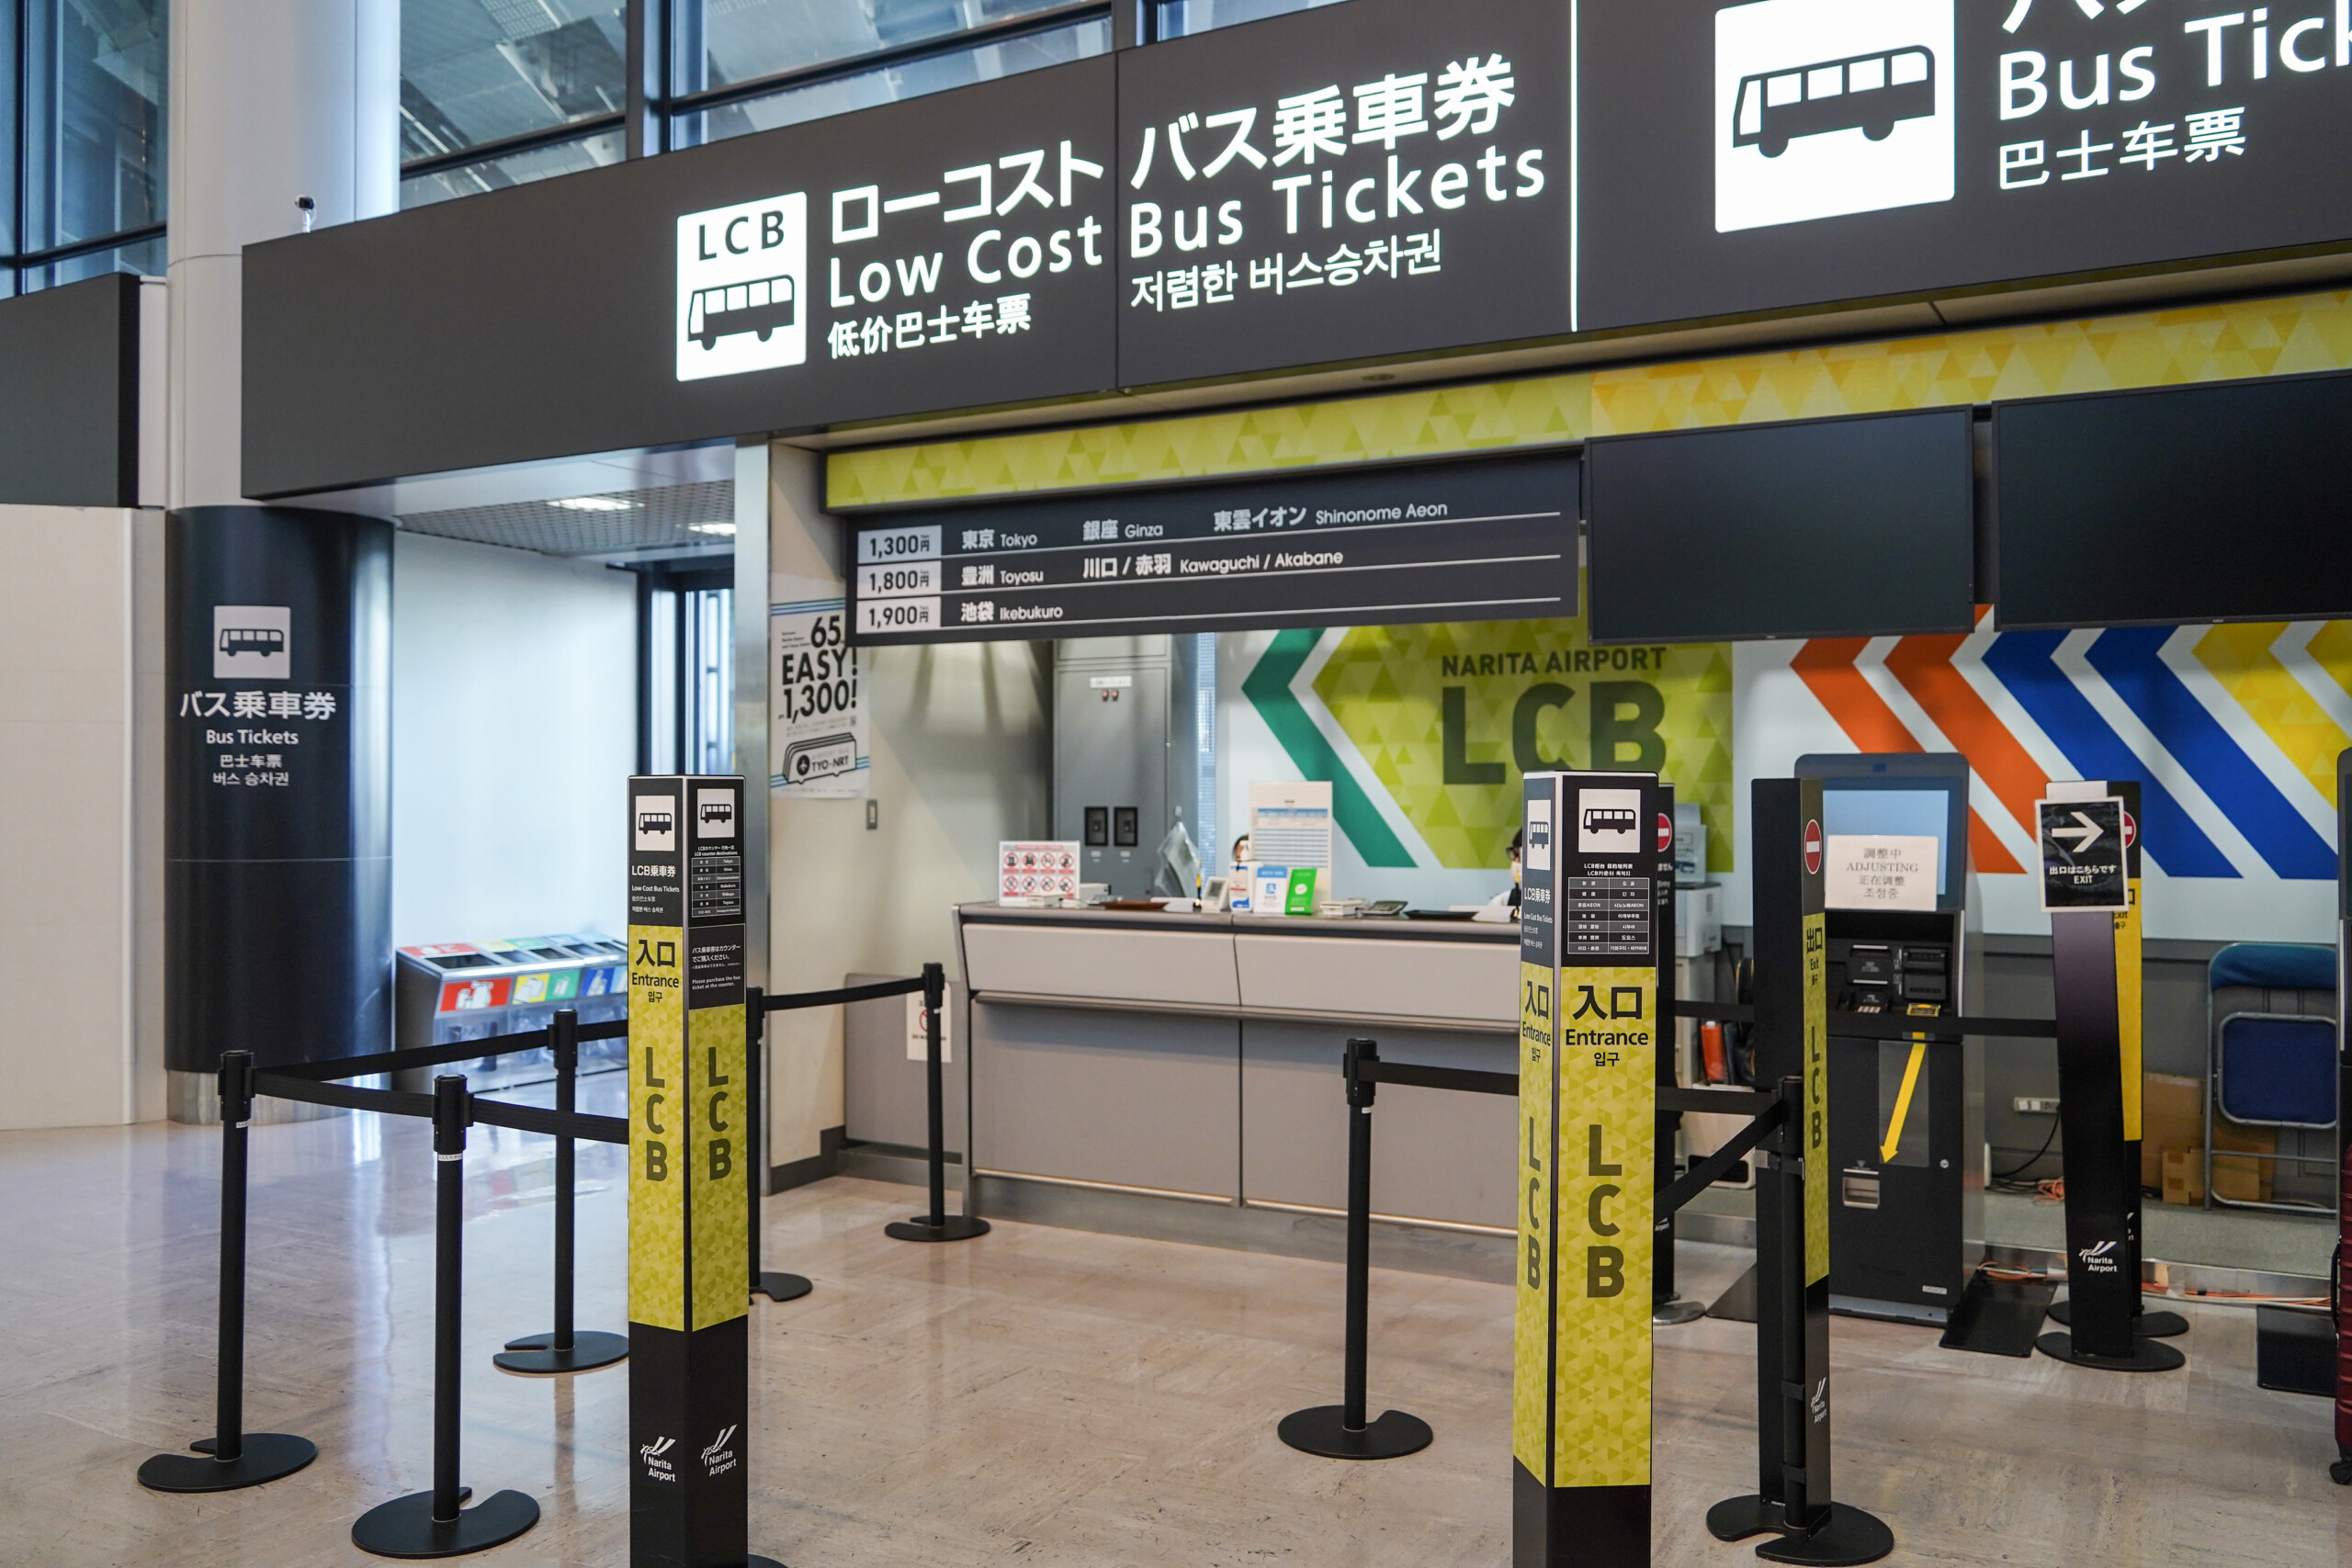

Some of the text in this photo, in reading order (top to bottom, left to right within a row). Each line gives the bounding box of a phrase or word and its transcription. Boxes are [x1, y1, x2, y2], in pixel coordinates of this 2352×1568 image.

[2000, 46, 2156, 120] Bus
[831, 52, 1515, 244] ローコスト バス乗車券
[2000, 107, 2245, 190] 巴士车票
[698, 209, 785, 261] LCB
[831, 144, 1544, 308] Low Cost Bus Tickets
[1131, 260, 1238, 312] 저렴한
[828, 292, 1031, 359] 低价巴士车票
[962, 529, 994, 550] 東京
[1001, 533, 1038, 548] Tokyo
[1083, 519, 1118, 541] 銀座
[1125, 524, 1164, 538] Ginza
[1214, 506, 1306, 533] 東雲イオン
[1316, 506, 1402, 525] Shinonome
[1406, 502, 1448, 519] Aeon
[961, 565, 994, 586] 豊洲
[1001, 570, 1044, 586] Toyosu
[1083, 558, 1117, 579] 川口
[1135, 553, 1171, 576] 赤羽
[1180, 555, 1260, 575] Kawaguchi
[1275, 550, 1343, 569] Akabane
[961, 601, 994, 622] 池袋
[1001, 604, 1063, 621] Ikebukuro
[811, 615, 842, 648] 65
[782, 646, 857, 685] EASY!
[1442, 647, 1667, 677] NARITA AIRPORT
[179, 690, 337, 720] バス乗車券
[784, 678, 857, 723] 1,300!
[206, 728, 299, 744] Bus Tickets
[1442, 680, 1667, 784] LCB
[220, 754, 282, 768] 巴士车票
[812, 755, 849, 772] TYO-NRT
[212, 772, 289, 786] 버스 승차권
[1863, 848, 1902, 859] 調整中
[632, 864, 676, 877] LCB乗車券
[1846, 862, 1918, 873] ADJUSTING
[1860, 875, 1905, 886] 正在调整
[2049, 864, 2117, 875] 出口はこちらです
[2074, 874, 2093, 885] EXIT
[1863, 887, 1898, 899] 조정중
[636, 939, 675, 968] 入口
[1806, 927, 1823, 954] 出口
[1811, 956, 1819, 970] Exit
[632, 972, 679, 988] Entrance
[648, 991, 662, 1003] 입구
[1525, 980, 1549, 1020] 入口
[1573, 986, 1642, 1021] 入口
[1522, 1021, 1551, 1046] Entrance
[1566, 1029, 1648, 1045] Entrance
[1594, 1052, 1620, 1066] 입구
[1812, 1026, 1822, 1149] LCB
[646, 1046, 668, 1182] LCB
[707, 1046, 731, 1181] LCB
[1528, 1116, 1541, 1291] LCB
[1587, 1124, 1624, 1298] LCB
[2087, 1264, 2118, 1273] Airport
[648, 1456, 672, 1471] Narita
[709, 1450, 733, 1466] Narita
[709, 1458, 737, 1477] Airport
[649, 1467, 676, 1483] Airport
